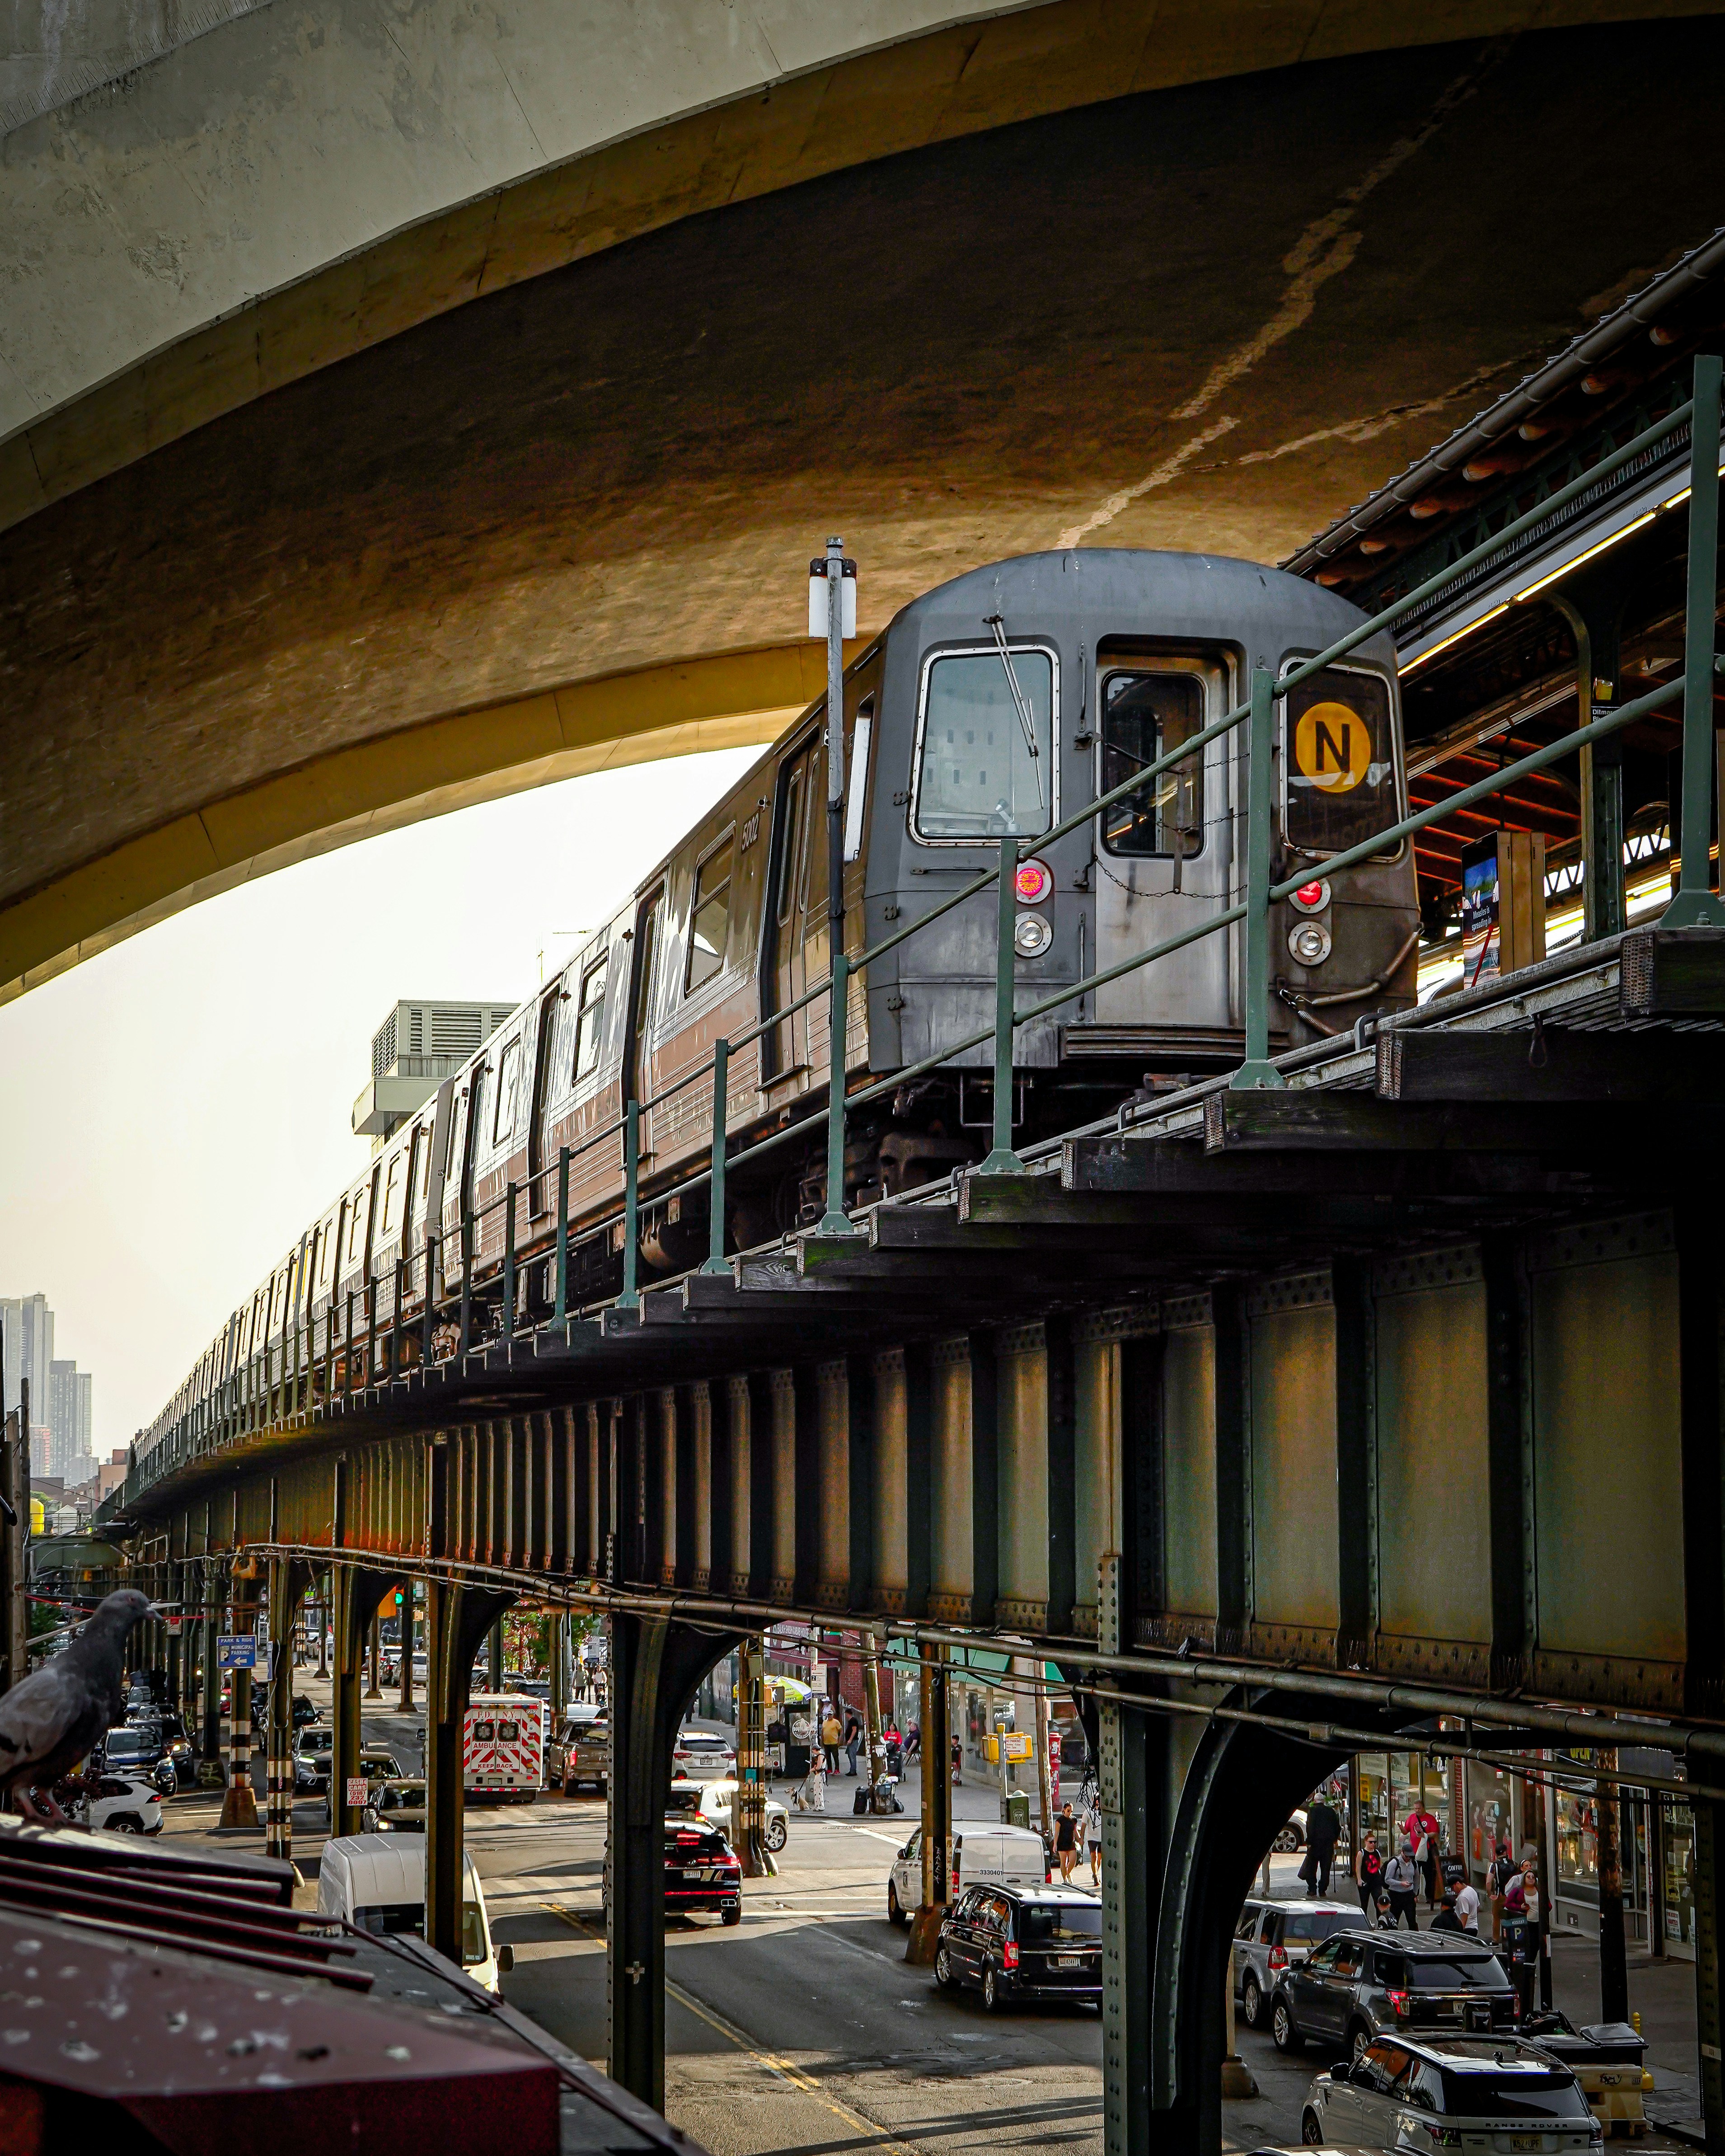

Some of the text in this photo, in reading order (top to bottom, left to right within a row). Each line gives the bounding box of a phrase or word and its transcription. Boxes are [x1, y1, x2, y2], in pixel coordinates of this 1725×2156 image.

[1315, 721, 1351, 773] N
[741, 812, 759, 850] 5002
[1473, 906, 1490, 919] Measles is
[1472, 916, 1492, 932] spreading in
[220, 1651, 229, 1662] P
[1514, 1927, 1522, 1940] P
